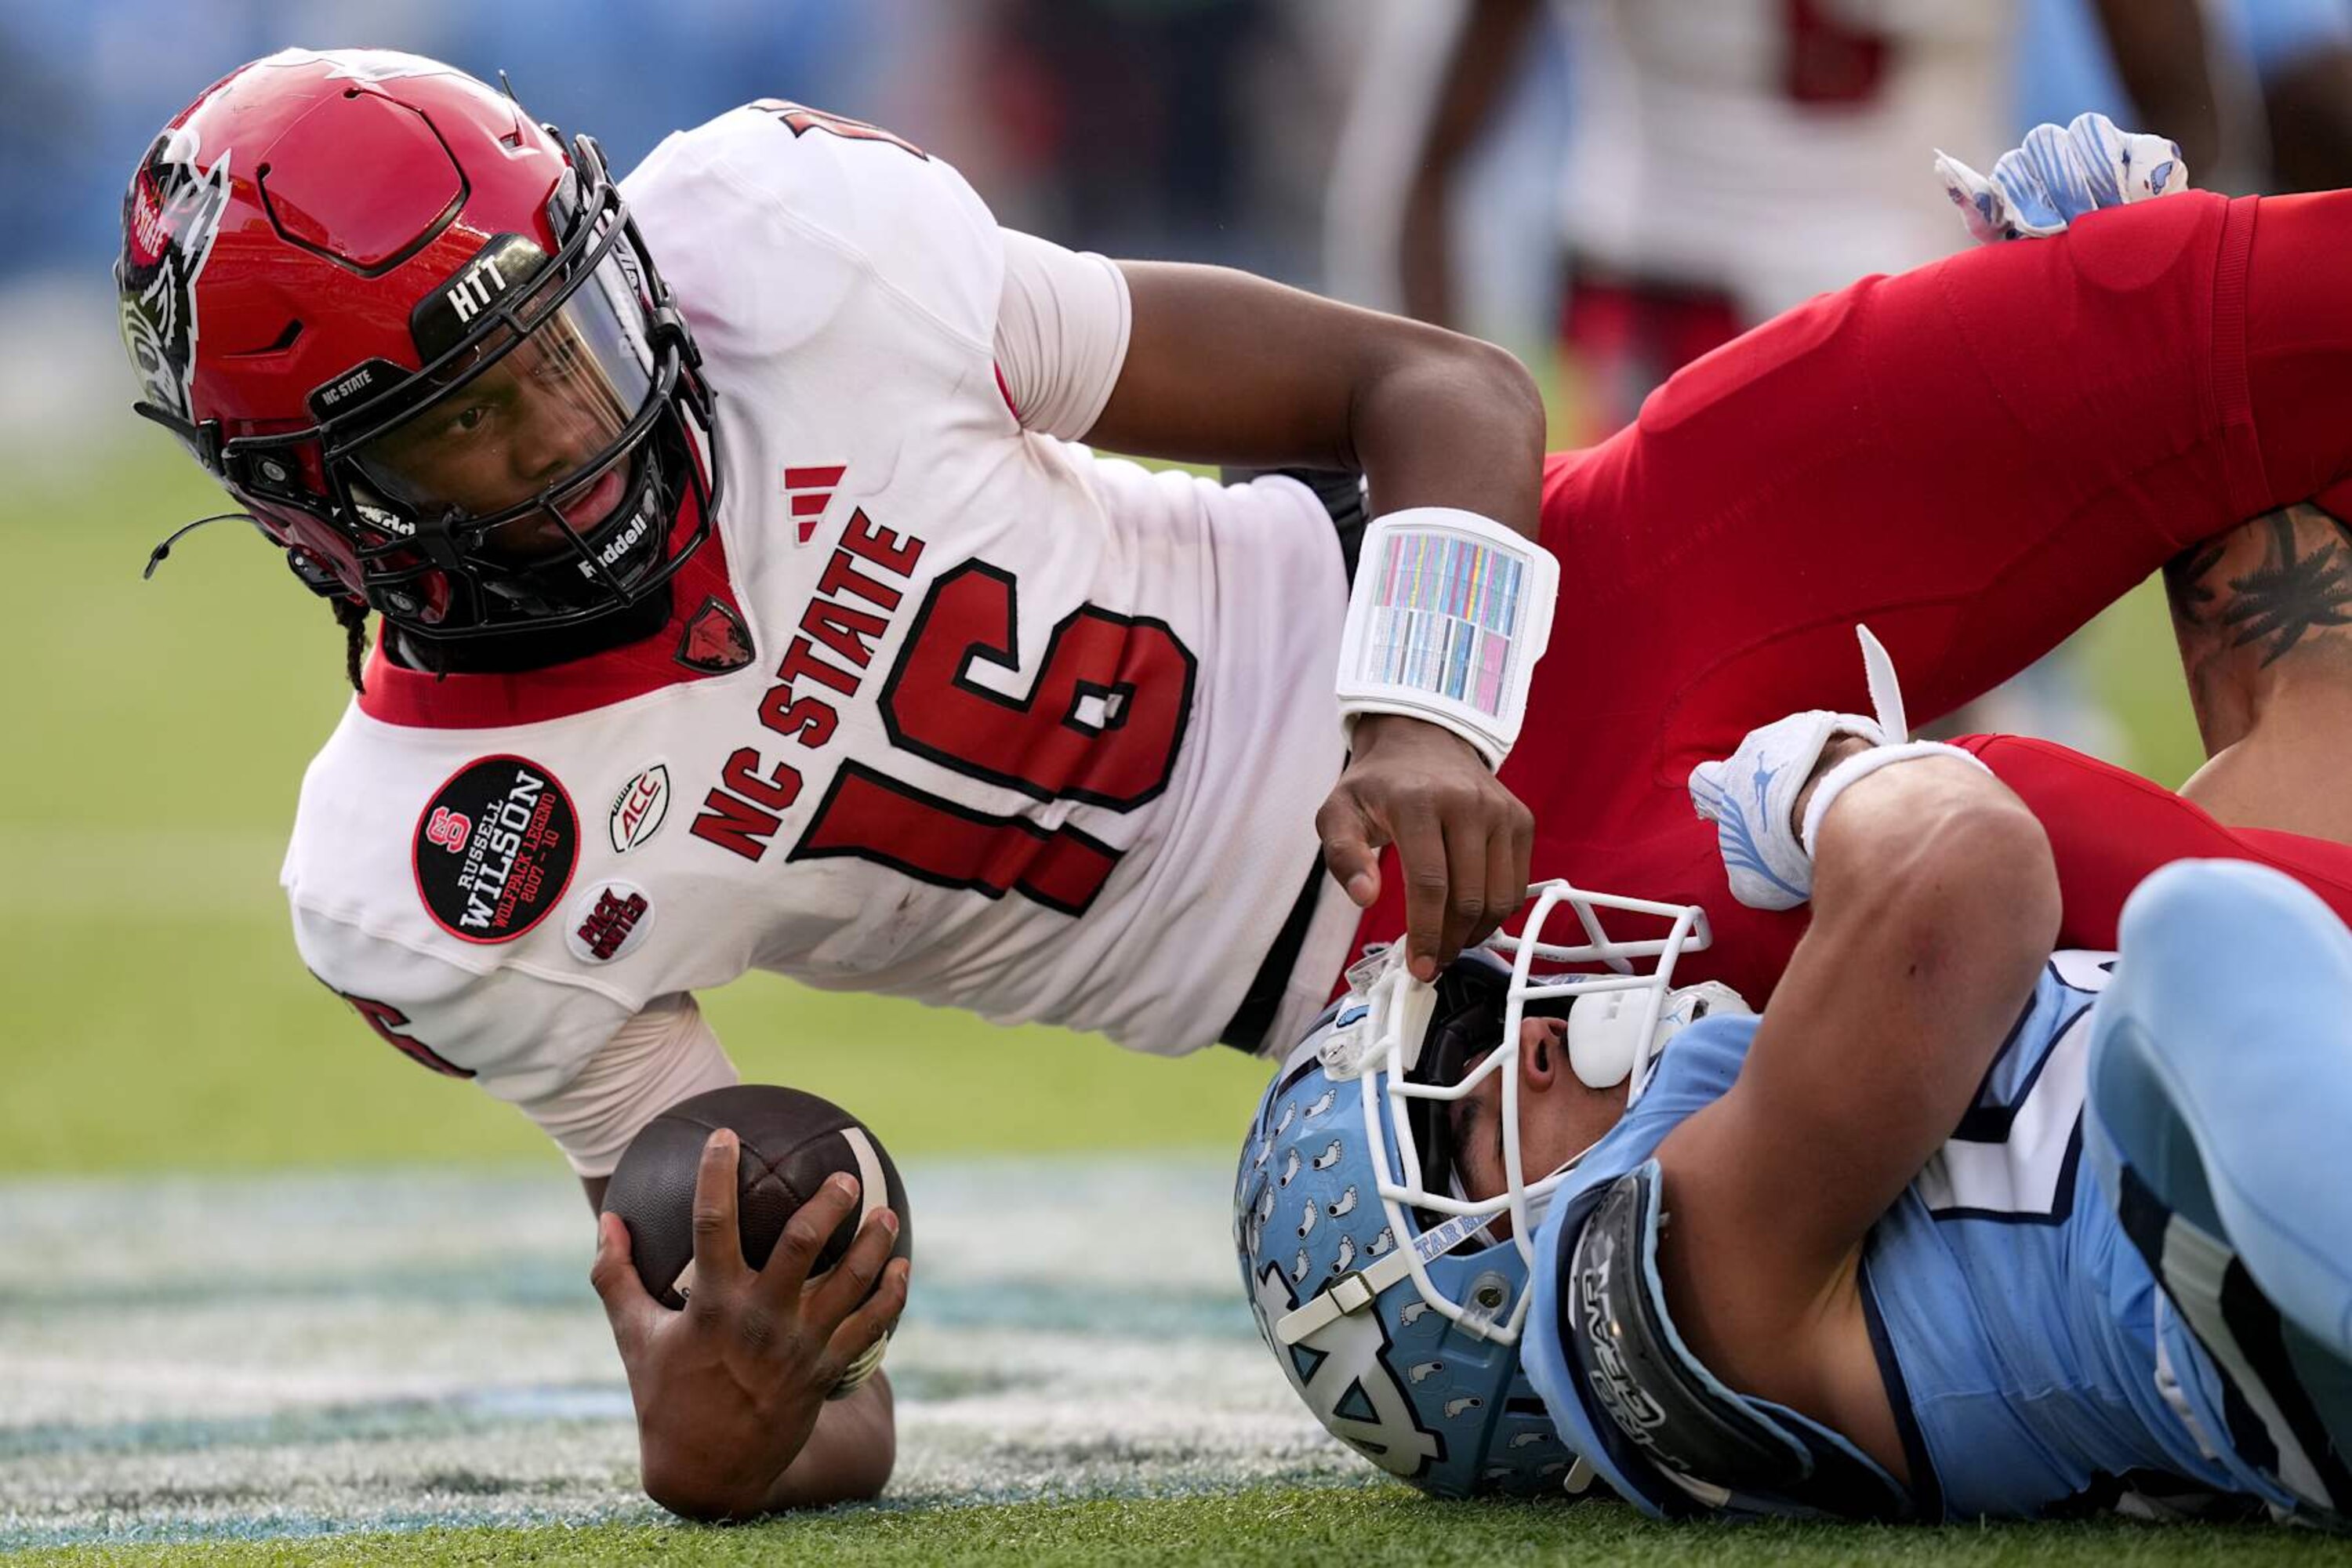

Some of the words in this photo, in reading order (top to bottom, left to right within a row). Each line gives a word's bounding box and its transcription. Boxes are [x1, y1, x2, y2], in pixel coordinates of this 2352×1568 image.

[446, 255, 506, 323] HTT
[321, 389, 341, 405] NC
[338, 369, 373, 397] STATE
[689, 747, 804, 862] NC
[757, 506, 926, 749] STATE
[785, 557, 1198, 919] 16
[622, 772, 658, 840] ACC
[458, 799, 505, 891] RUSSELL
[459, 770, 544, 928] WILSON
[492, 851, 533, 929] WOLFPACK
[523, 792, 557, 851] LEGEND
[521, 866, 545, 902] 2007
[542, 829, 560, 848] 10
[577, 887, 627, 948] PACK
[1414, 1224, 1462, 1260] TAR
